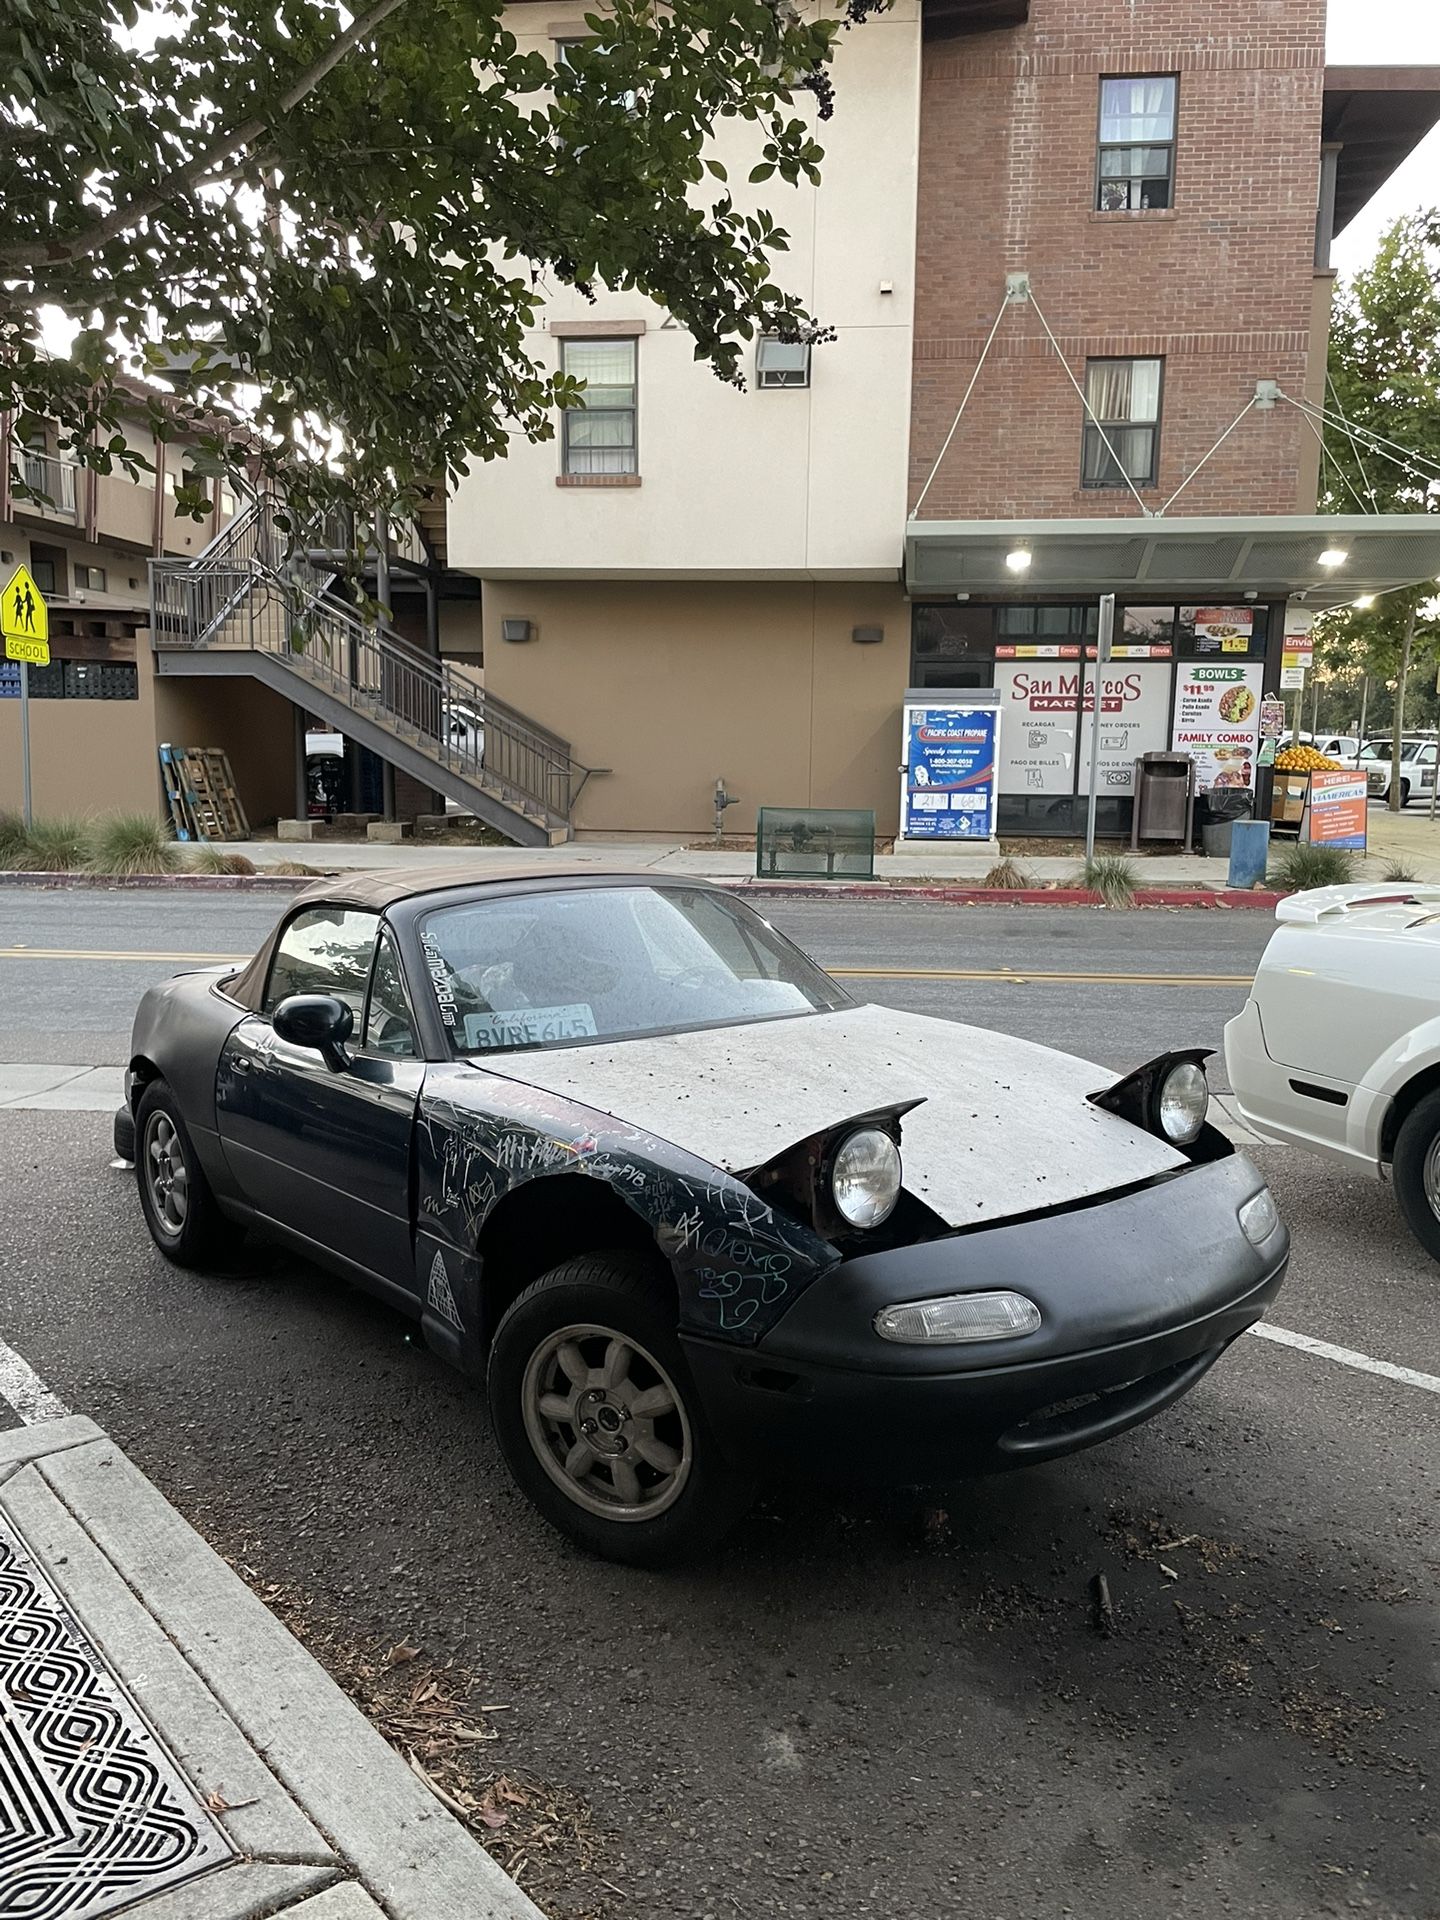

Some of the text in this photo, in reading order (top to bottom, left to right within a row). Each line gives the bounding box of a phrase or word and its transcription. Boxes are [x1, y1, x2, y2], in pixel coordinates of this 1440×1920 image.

[1285, 637, 1313, 647] Envía
[9, 642, 46, 659] SCHOOL
[1151, 646, 1170, 655] Envía
[1198, 669, 1237, 679] BOWLS
[1012, 673, 1141, 701] San MacoS
[1183, 685, 1215, 695] $11.99
[927, 729, 988, 737] PACIFIC COAST PROPANE
[1178, 733, 1254, 743] FAMILY COMBO
[923, 747, 946, 756] Speedy
[1323, 775, 1351, 785] HERE!
[1312, 790, 1364, 802] VIAMERICAS
[491, 1010, 564, 1025] California
